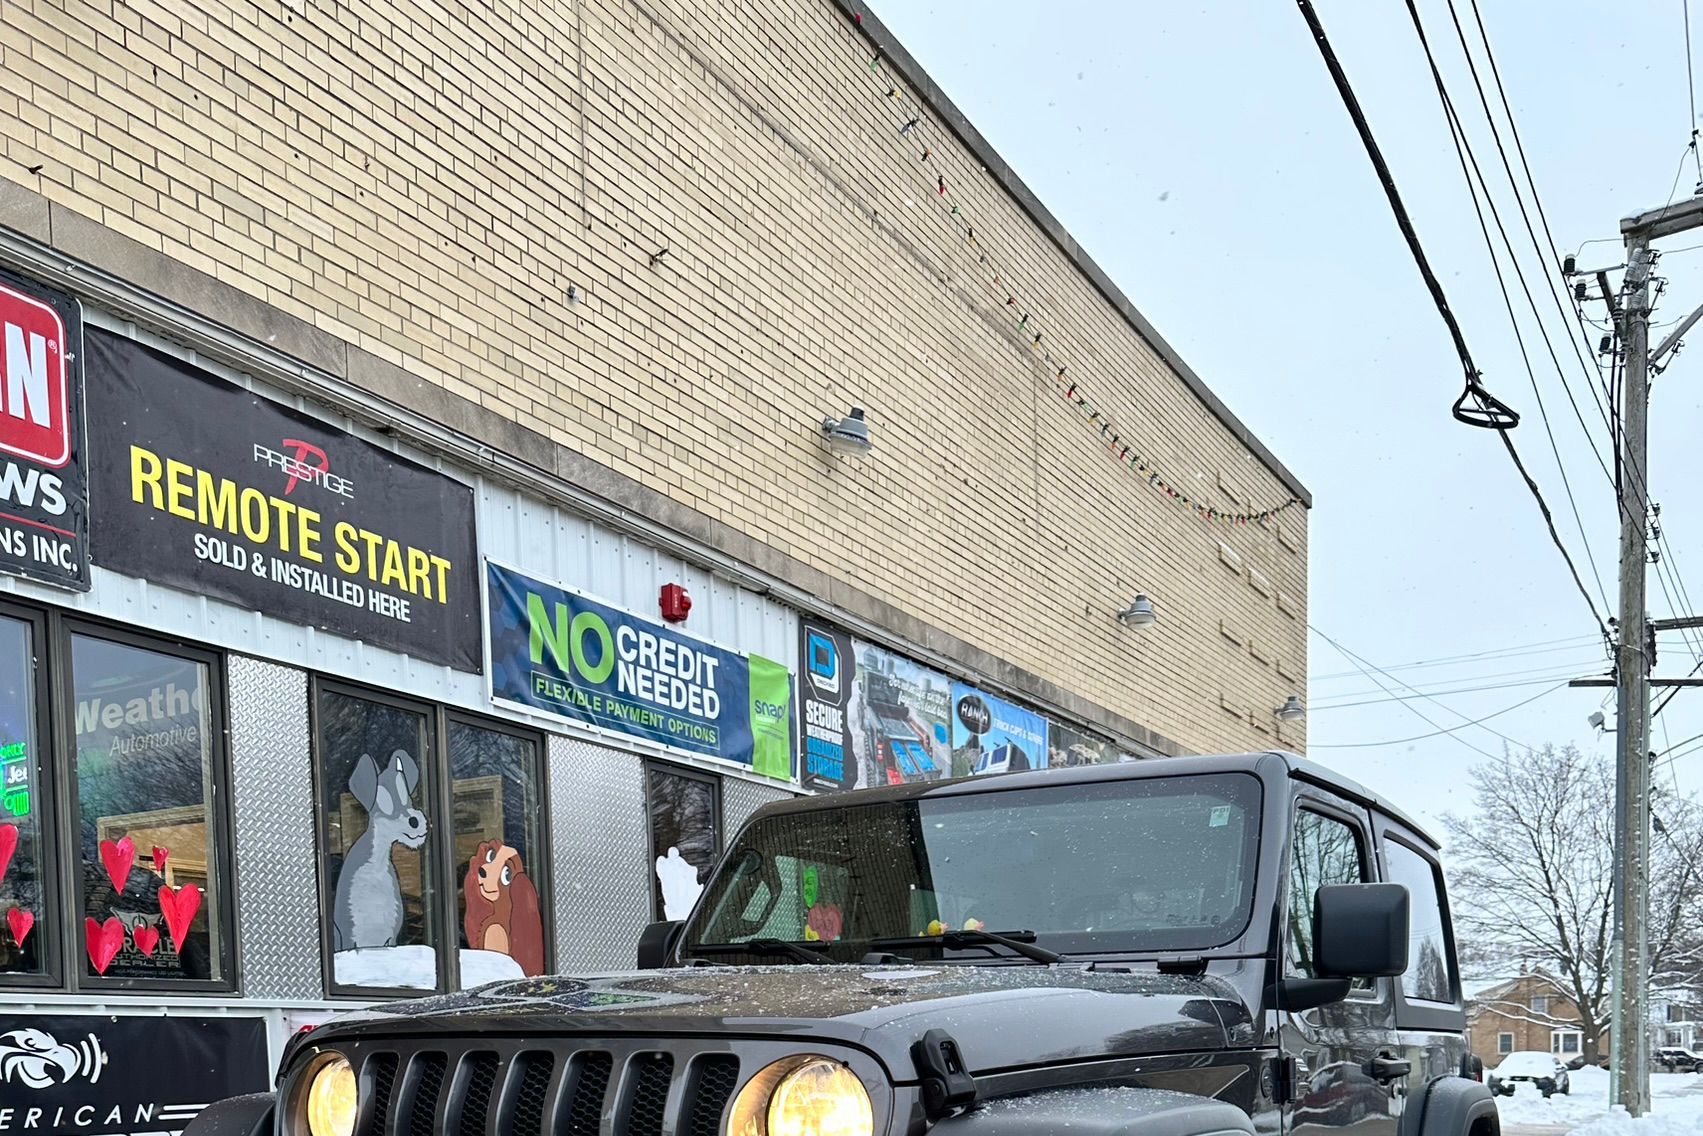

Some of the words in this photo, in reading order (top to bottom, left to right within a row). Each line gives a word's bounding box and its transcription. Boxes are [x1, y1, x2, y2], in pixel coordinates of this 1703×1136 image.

[253, 443, 355, 499] PRESTIGE
[130, 445, 324, 564] REMOTE
[335, 521, 452, 605] START
[32, 534, 78, 573] INC.
[194, 533, 248, 572] SOLD
[252, 552, 268, 578] &
[271, 557, 365, 609] INSTALLED
[368, 590, 411, 623] HERE
[526, 591, 616, 684] NO
[615, 624, 720, 689] CREDIT
[536, 678, 602, 713] FLEXIBLE
[606, 693, 664, 733] PAYMENT
[668, 715, 717, 744] OPTIONS
[617, 659, 721, 721] NEEDED
[806, 699, 843, 733] SECURE
[961, 703, 989, 724] RANCH
[109, 723, 197, 757] Automotive
[807, 753, 844, 782] STORAGE
[0, 1103, 154, 1129] ERICAN
